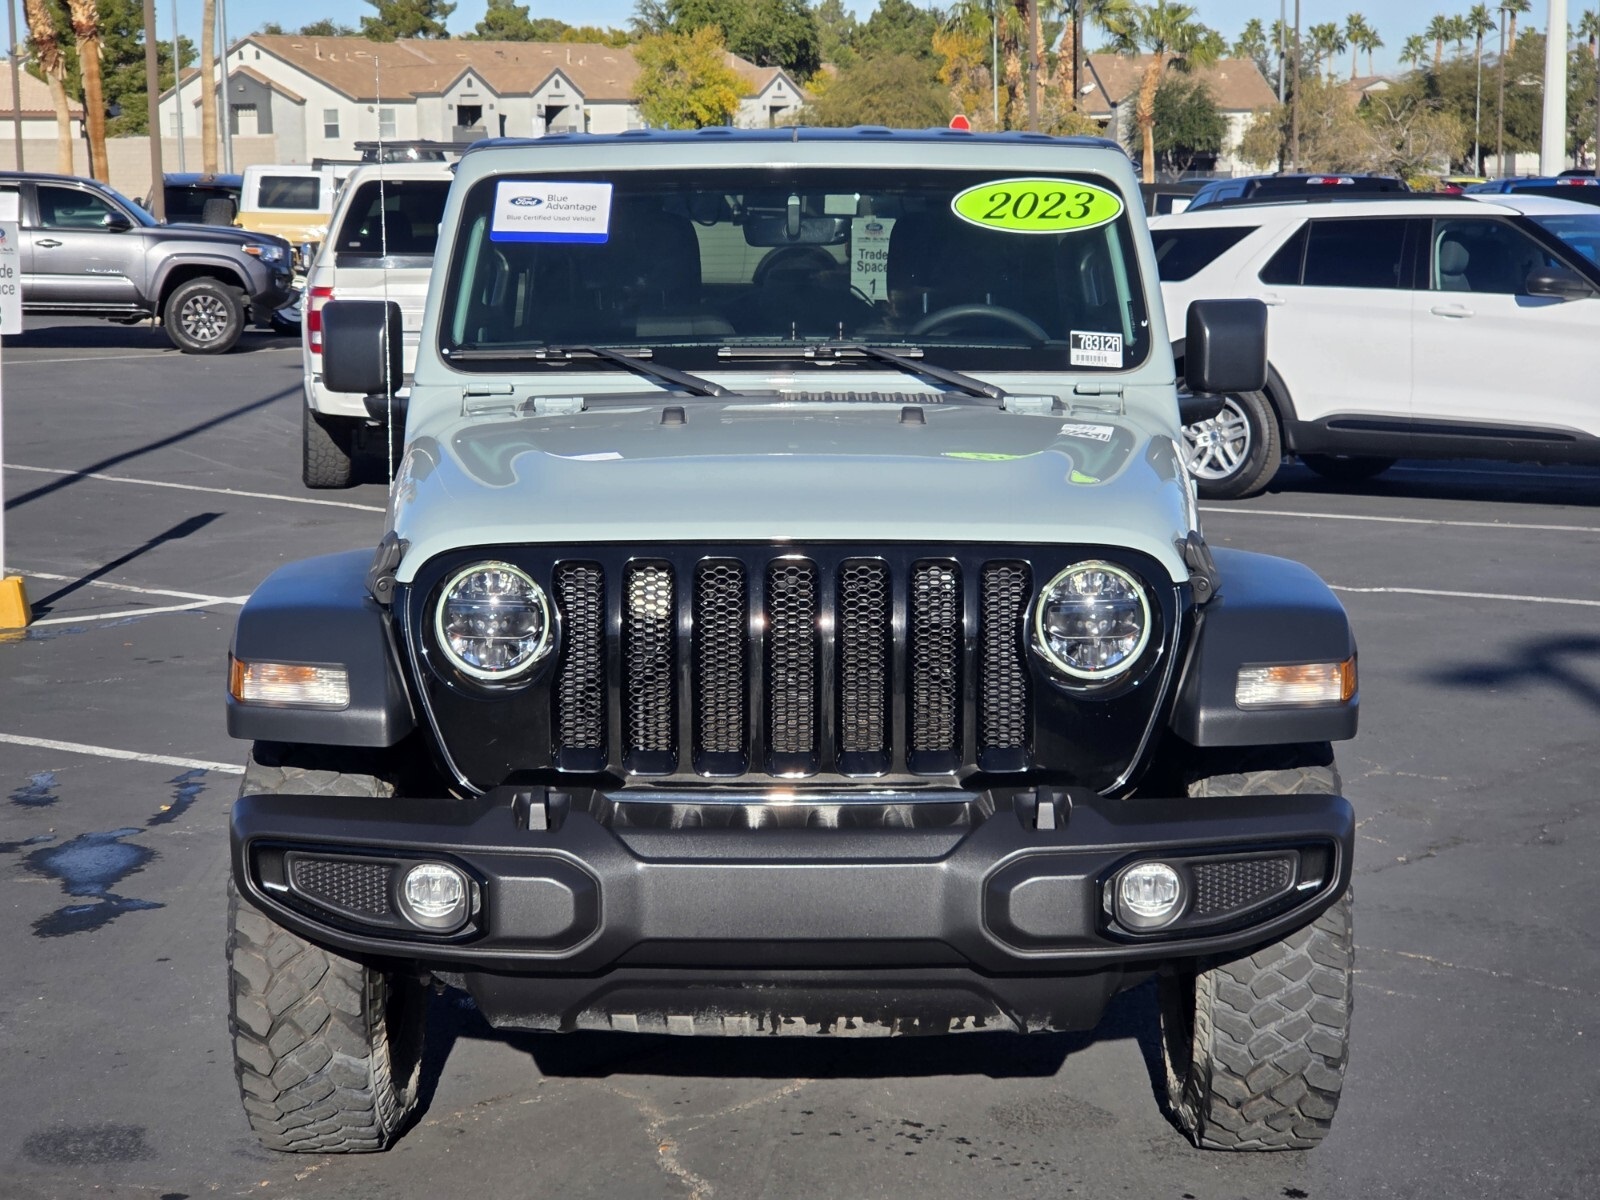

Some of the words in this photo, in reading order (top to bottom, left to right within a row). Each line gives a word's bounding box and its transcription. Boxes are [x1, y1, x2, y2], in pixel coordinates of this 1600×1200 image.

[514, 196, 538, 206] Ford
[547, 194, 568, 202] Blue
[546, 202, 597, 211] Advantage
[982, 191, 1095, 219] 2023
[859, 248, 888, 260] Trade
[869, 278, 876, 295] 1
[1078, 334, 1120, 352] 78312A
